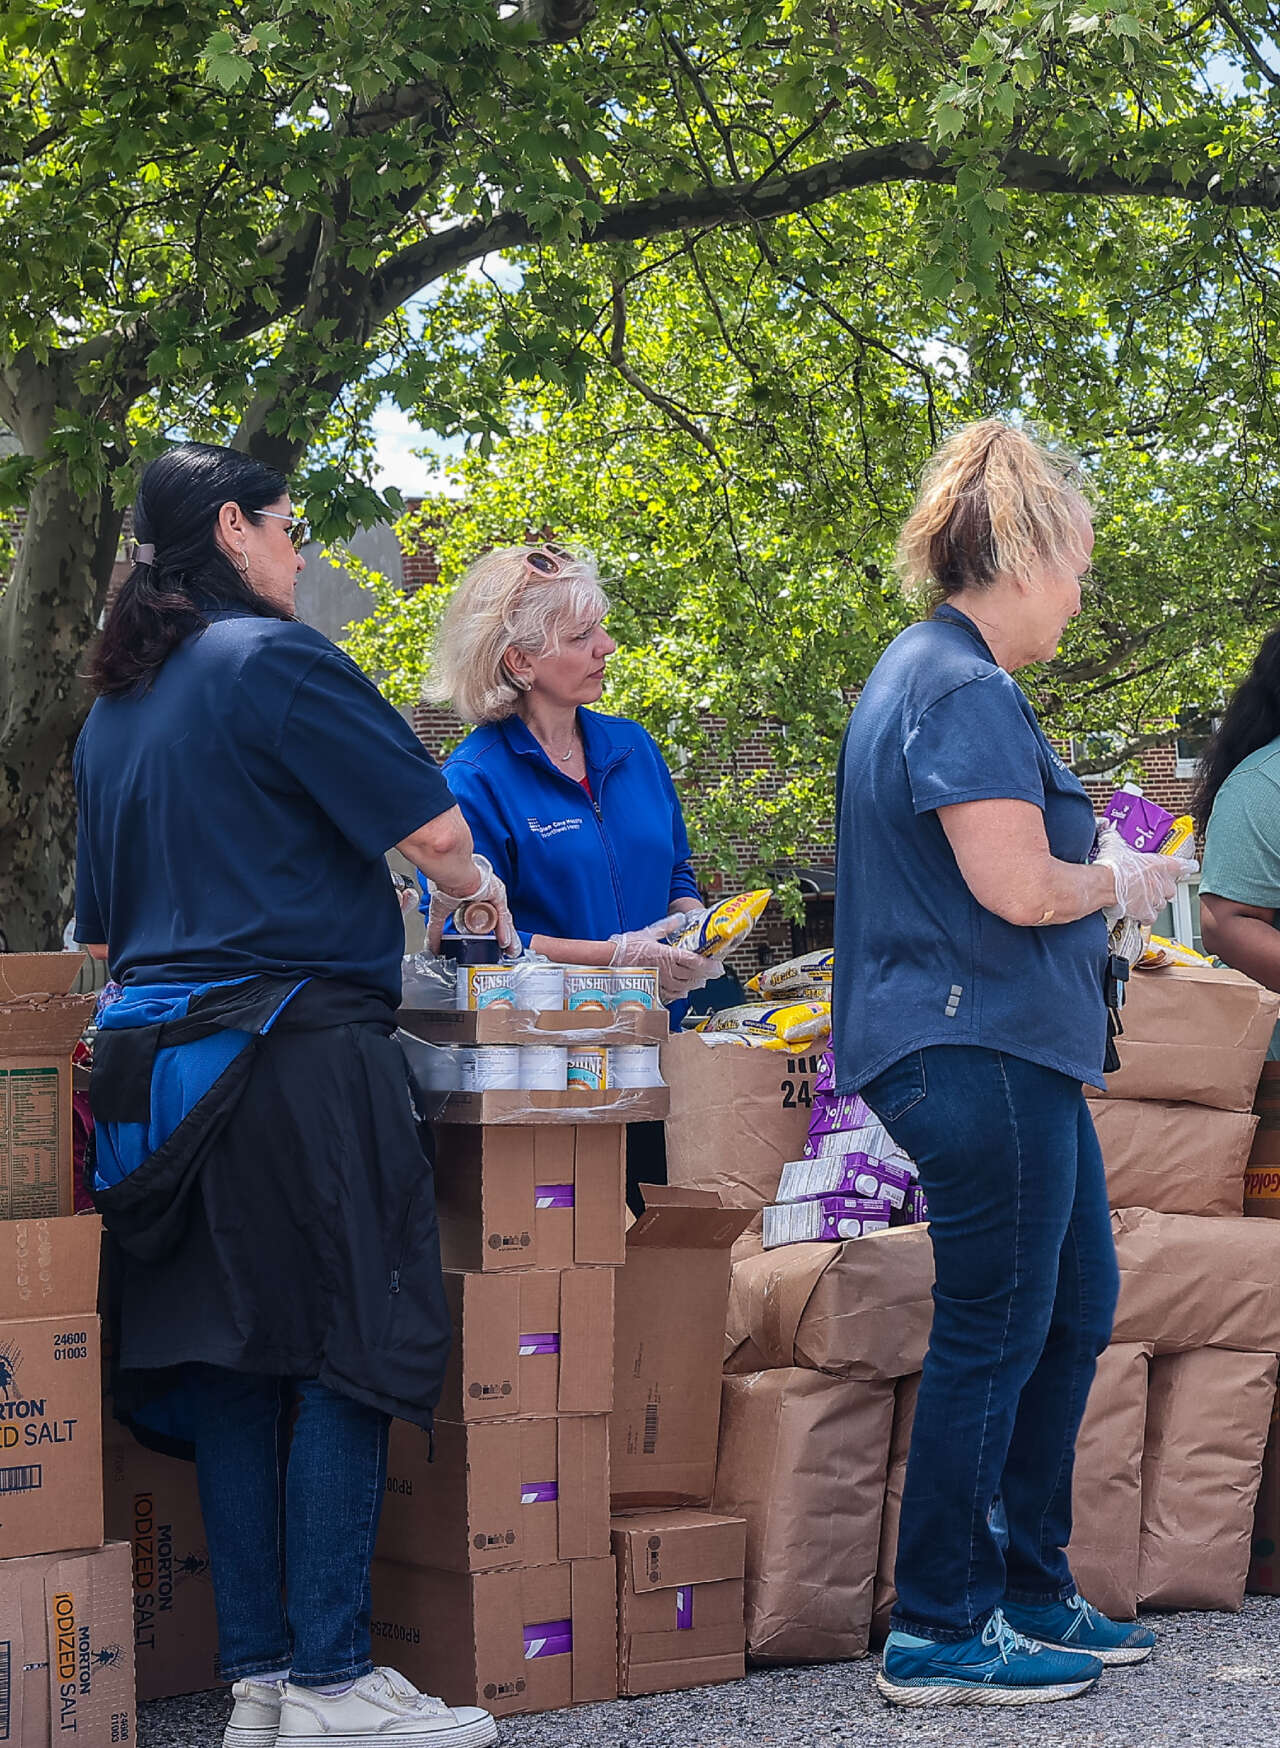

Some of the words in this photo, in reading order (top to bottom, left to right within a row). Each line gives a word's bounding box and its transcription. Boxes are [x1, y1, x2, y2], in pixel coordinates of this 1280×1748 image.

[53, 1333, 87, 1346] 24600
[54, 1347, 87, 1360] 01003
[0, 1399, 46, 1420] RTON
[24, 1419, 78, 1446] SALT
[134, 1492, 153, 1588] IODIZED
[158, 1525, 172, 1611] MORTON
[55, 1594, 76, 1679] IODIZED
[135, 1594, 155, 1648] SALT
[79, 1626, 91, 1695] MORTON
[60, 1683, 77, 1732] SALT
